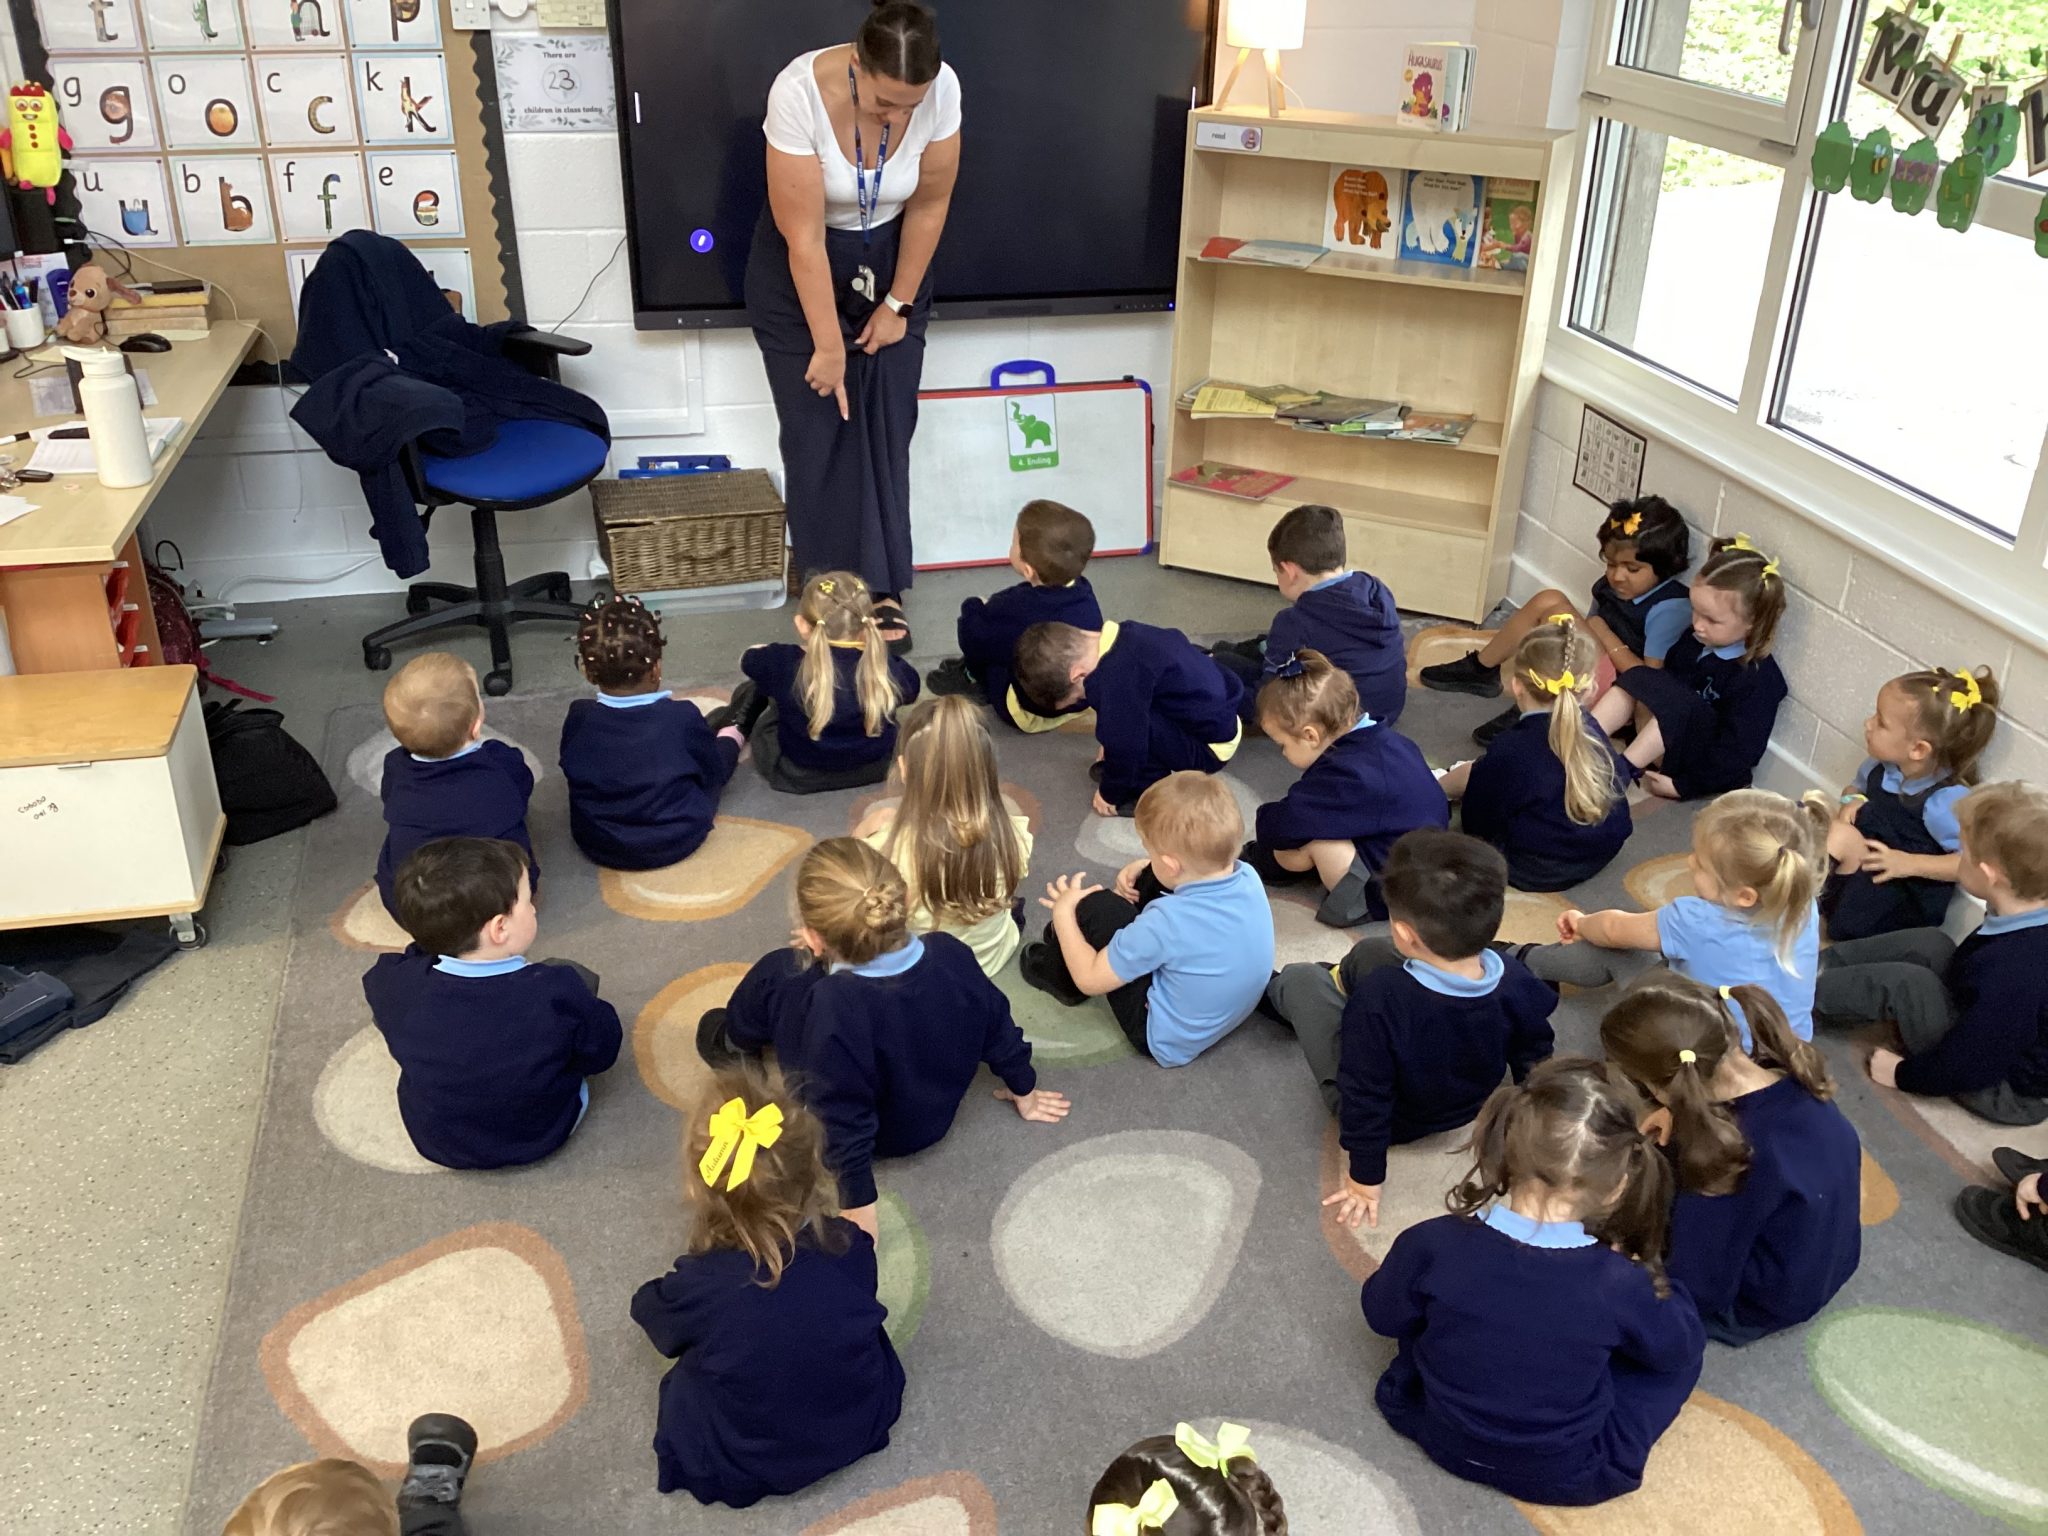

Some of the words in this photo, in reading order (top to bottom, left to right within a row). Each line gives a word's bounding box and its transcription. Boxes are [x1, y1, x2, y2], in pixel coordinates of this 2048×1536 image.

[168, 74, 186, 94] o
[267, 72, 282, 93] c
[366, 61, 384, 91] k
[548, 69, 575, 91] 23
[63, 77, 81, 107] g
[401, 76, 437, 133] k
[99, 85, 134, 144] g
[307, 95, 336, 134] c
[82, 171, 103, 192] u
[182, 163, 200, 193] b
[283, 161, 296, 193] f
[378, 166, 393, 186] e
[218, 176, 253, 232] b
[317, 173, 341, 233] f
[413, 190, 440, 227] e
[706, 1141, 728, 1178] Autumn
